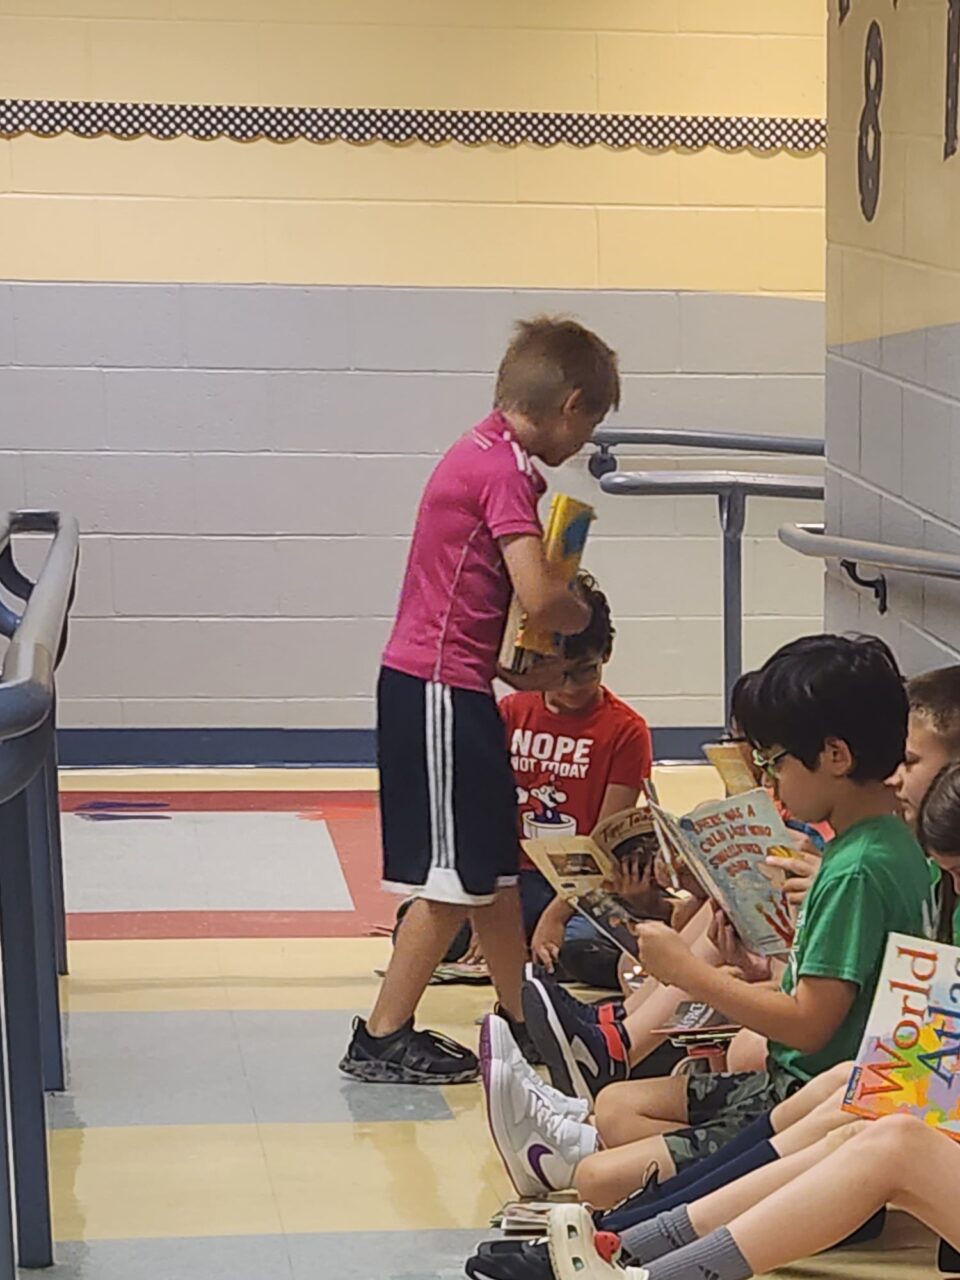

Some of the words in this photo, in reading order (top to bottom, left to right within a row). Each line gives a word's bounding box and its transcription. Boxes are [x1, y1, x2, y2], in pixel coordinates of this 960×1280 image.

[857, 19, 884, 222] 8
[511, 728, 594, 764] NOPE
[511, 757, 540, 774] NOT
[541, 760, 589, 779] TODAY
[748, 805, 756, 817] A
[858, 945, 938, 1100] World
